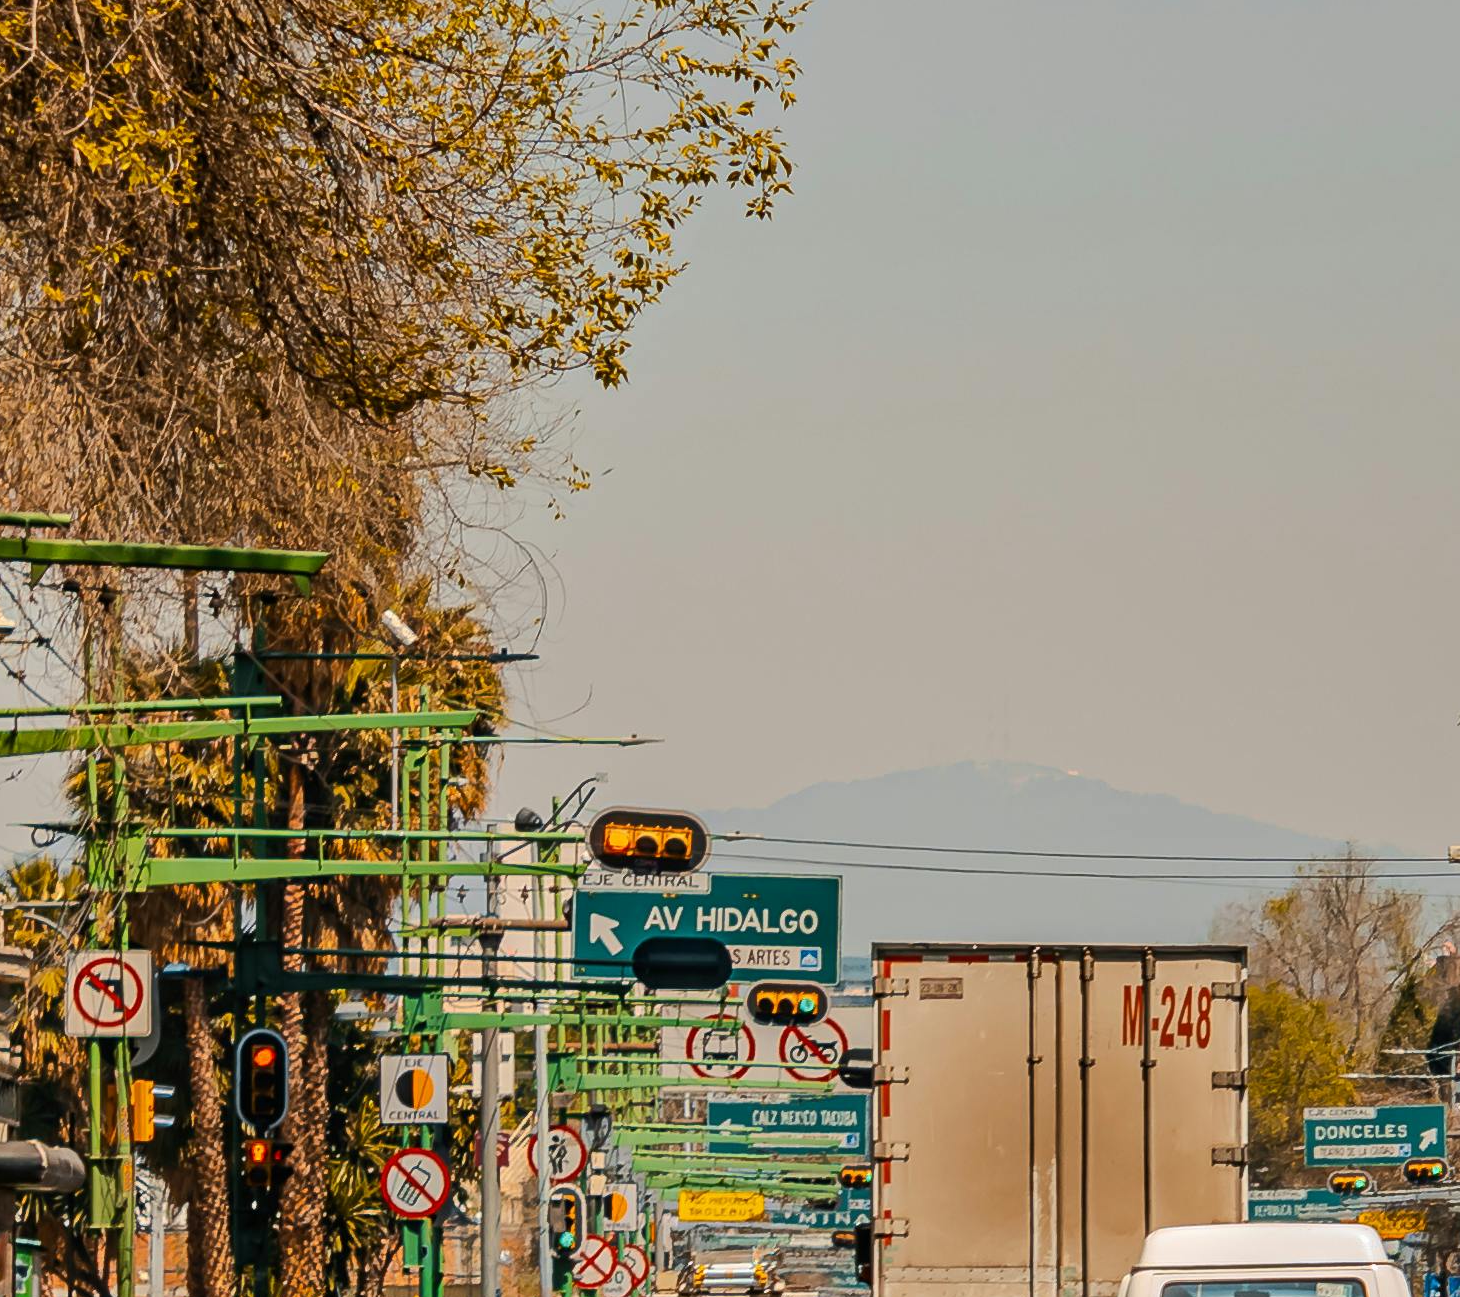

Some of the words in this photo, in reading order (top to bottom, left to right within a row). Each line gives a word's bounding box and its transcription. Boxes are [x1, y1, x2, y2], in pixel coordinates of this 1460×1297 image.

[582, 874, 614, 887] EJE
[622, 874, 700, 888] CENTRAL
[644, 907, 683, 931] AV
[696, 906, 819, 934] HIDALGO
[747, 950, 790, 966] ARTES
[1122, 984, 1212, 1051] M-248
[404, 1058, 424, 1067] EJE
[388, 1111, 440, 1122] CENTRAL
[1315, 1124, 1408, 1141] DONCELES
